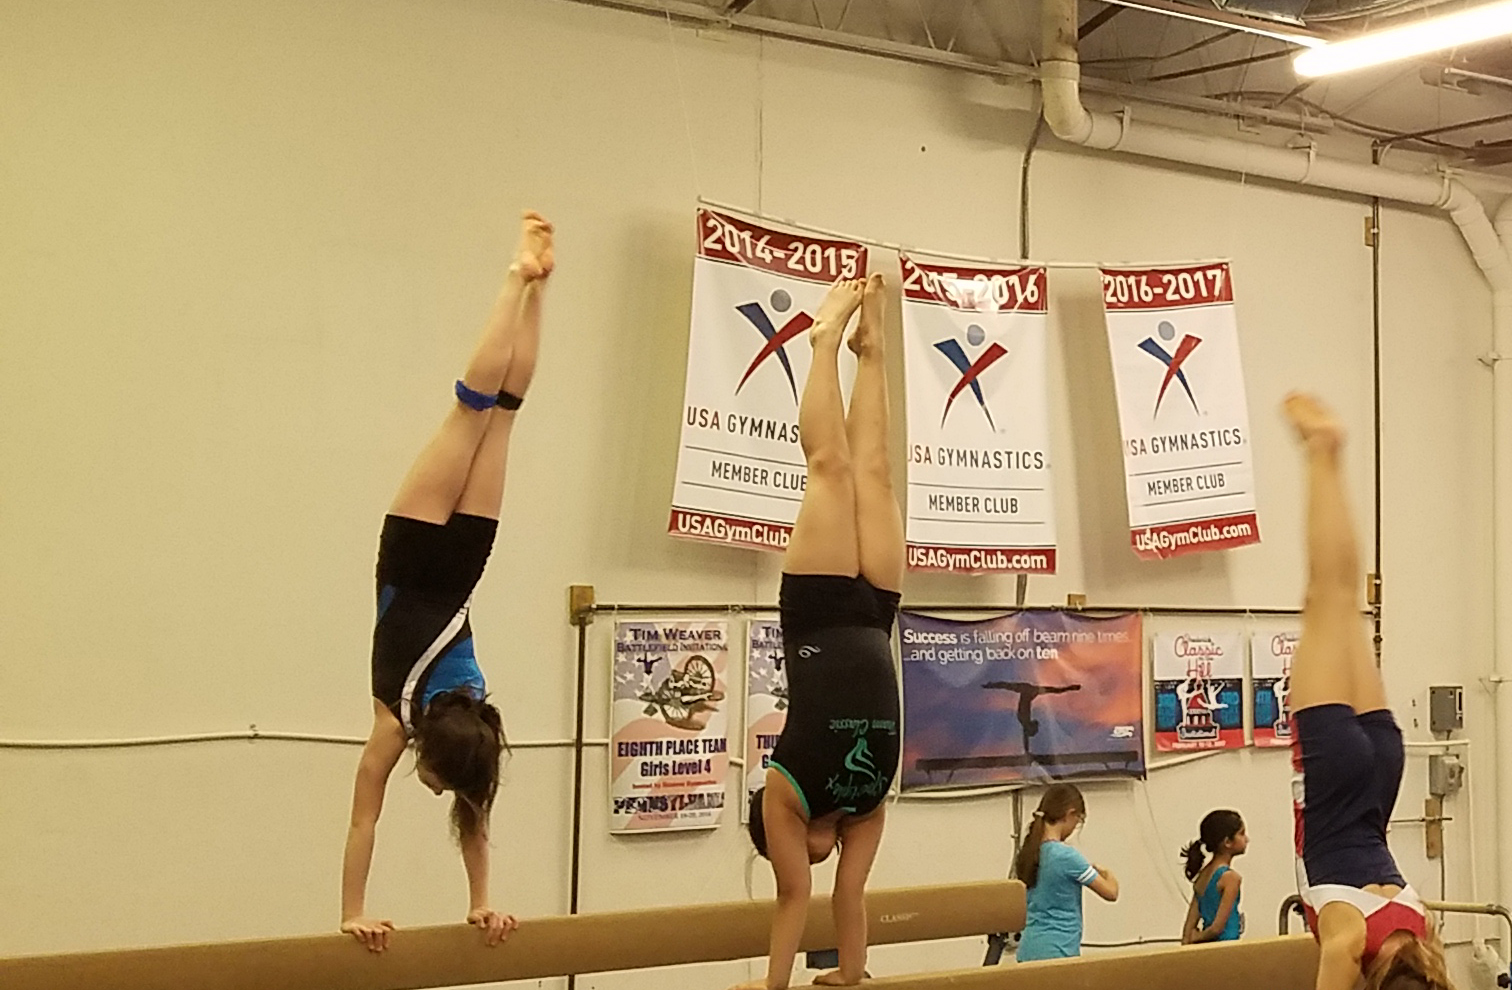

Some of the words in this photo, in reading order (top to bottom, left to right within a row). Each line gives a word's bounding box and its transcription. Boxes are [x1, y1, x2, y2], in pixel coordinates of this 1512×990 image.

[703, 218, 857, 279] 2014-2015
[1103, 268, 1222, 303] 2016-2017
[687, 406, 720, 431] USA
[1126, 438, 1147, 456] SA
[1151, 428, 1241, 454] GYMNASTICS
[937, 447, 1044, 470] GYMNASTICS
[711, 460, 769, 486] MEMBER
[1147, 476, 1194, 496] MEMBER
[1197, 473, 1225, 490] CLUB
[929, 494, 980, 512] MEMBER
[984, 497, 1018, 514] CLUB
[1136, 522, 1251, 551] USAGymClub.com
[908, 547, 1047, 570] USAGymClub.com
[629, 628, 658, 641] TIM
[663, 628, 721, 640] WEAVER
[904, 629, 957, 645] Success
[960, 631, 971, 644] is
[973, 630, 1013, 649] falling
[1014, 630, 1030, 643] off
[1033, 629, 1070, 644] beam
[1072, 631, 1095, 644] nine
[617, 642, 678, 653] BATTLEFIELD
[938, 648, 983, 665] getting
[986, 648, 1015, 661] back
[1017, 649, 1035, 661] on
[1175, 636, 1223, 658] Classic
[618, 741, 663, 757] EIGHTH
[666, 740, 699, 755] PLACE
[702, 738, 727, 754] TEAM
[641, 761, 669, 776] Girls
[672, 759, 702, 775] Level
[704, 759, 711, 773] 4
